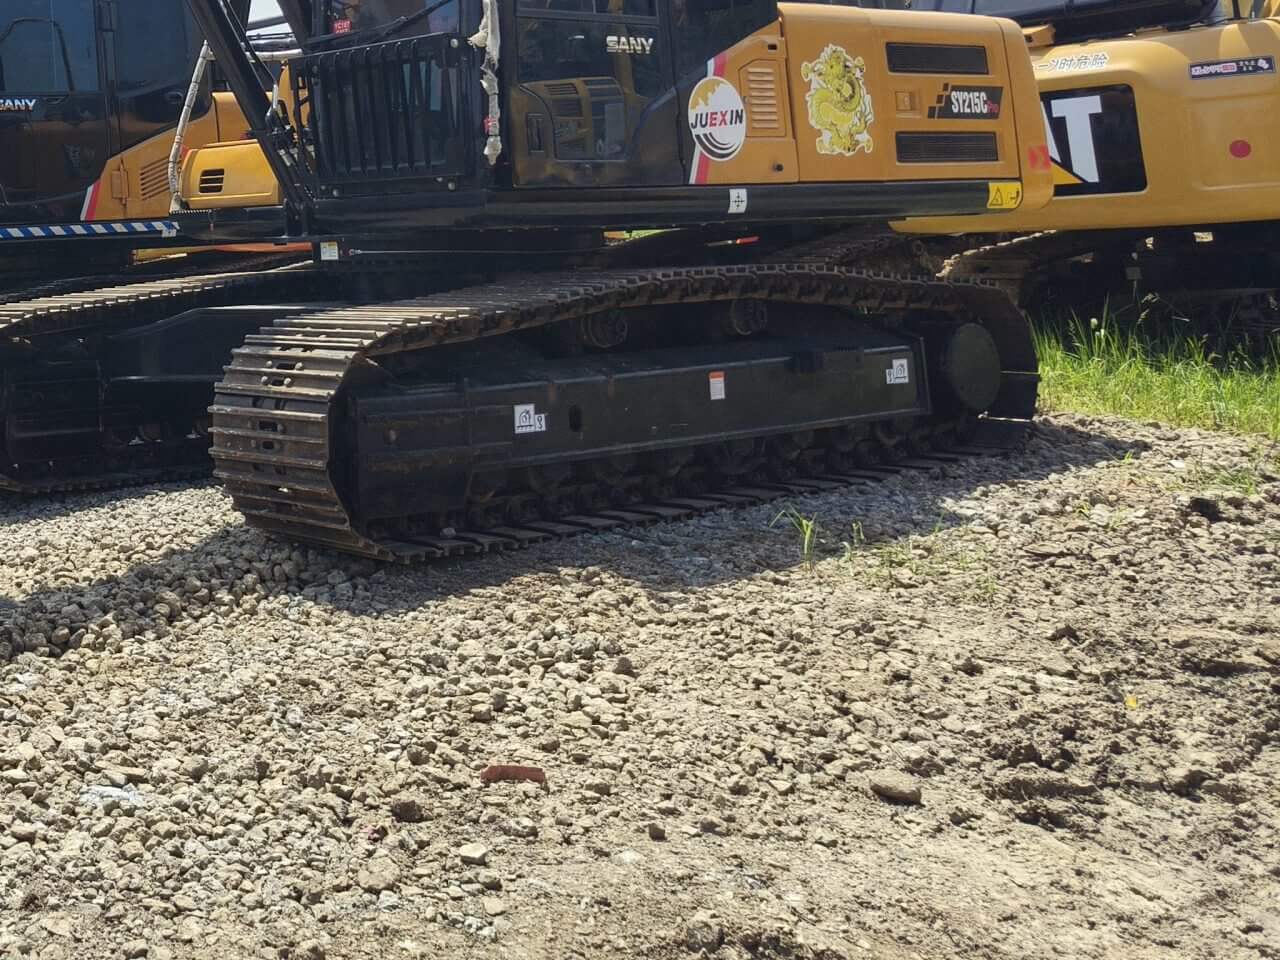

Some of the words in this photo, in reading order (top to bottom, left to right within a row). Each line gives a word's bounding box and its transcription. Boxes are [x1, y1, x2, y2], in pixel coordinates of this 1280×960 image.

[606, 36, 654, 54] SANY
[951, 90, 987, 113] SY215C
[690, 108, 744, 129] JUEXIN
[1040, 95, 1103, 183] T
